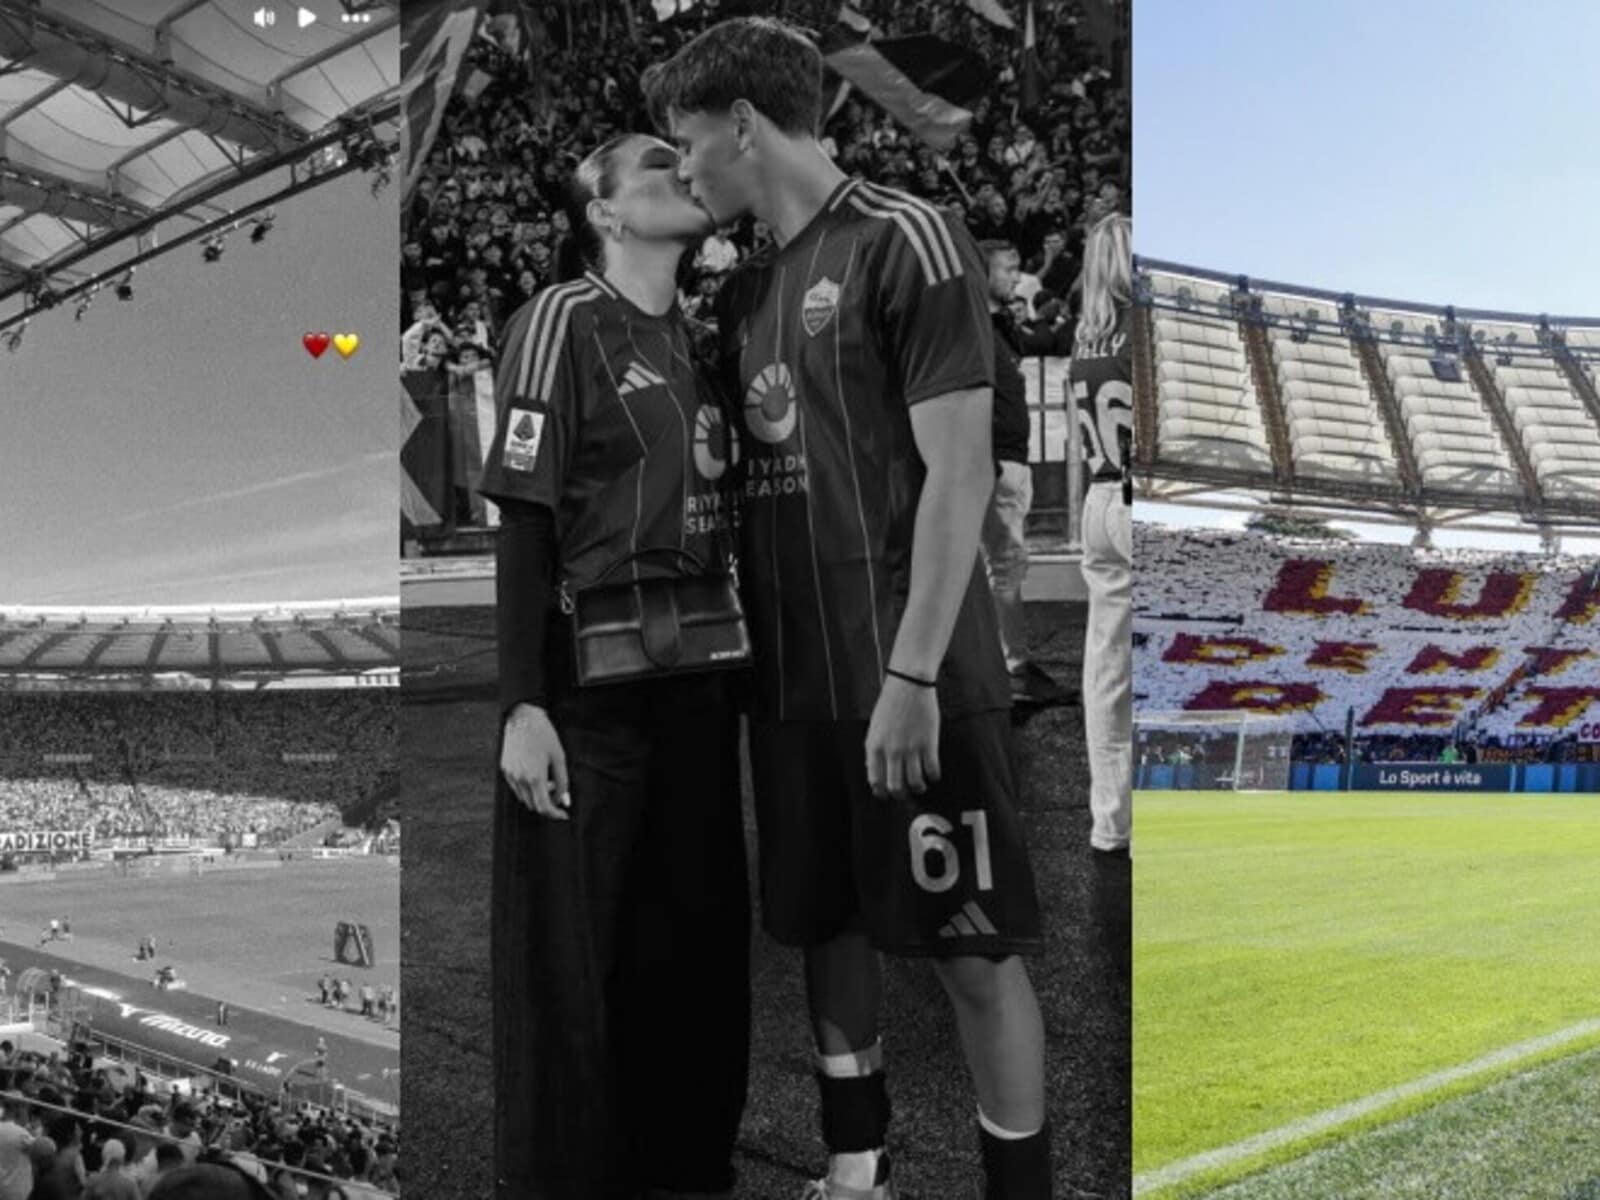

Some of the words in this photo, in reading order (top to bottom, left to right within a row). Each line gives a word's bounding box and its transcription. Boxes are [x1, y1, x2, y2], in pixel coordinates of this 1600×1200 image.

[745, 475, 809, 498] EASON
[1379, 771, 1397, 784] Lo
[1400, 770, 1440, 787] Sport
[1453, 770, 1482, 784] vita
[0, 832, 91, 849] ADIZIONE
[909, 810, 993, 893] 61
